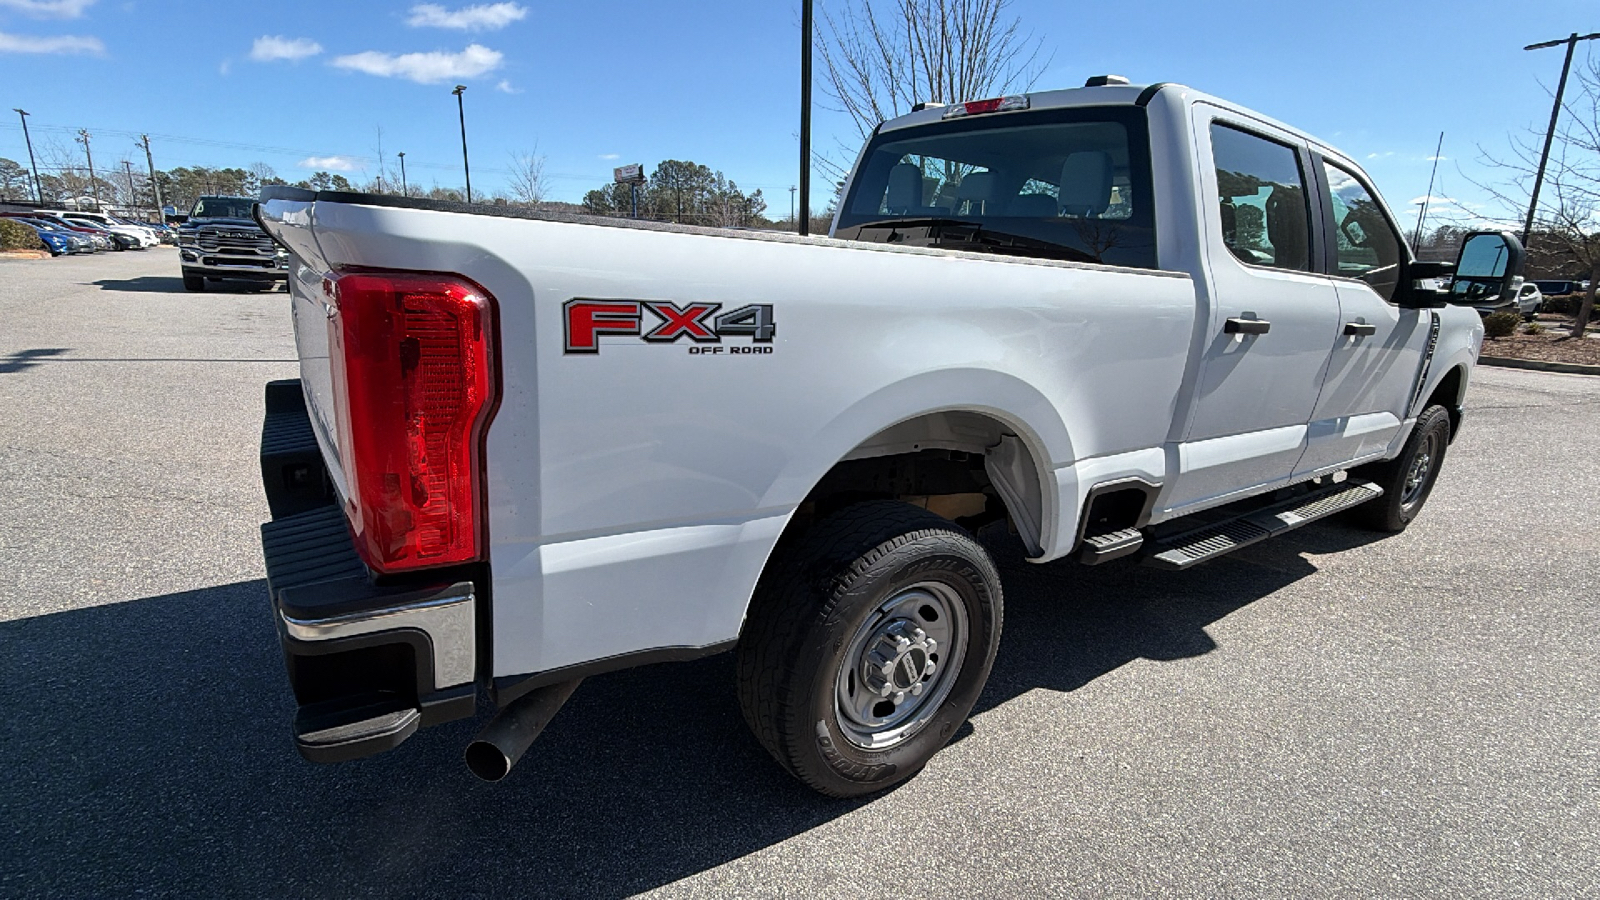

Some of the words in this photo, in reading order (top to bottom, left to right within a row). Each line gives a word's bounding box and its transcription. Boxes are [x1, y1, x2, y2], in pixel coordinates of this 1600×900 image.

[563, 297, 775, 355] FX4
[688, 346, 724, 355] OFF
[729, 346, 774, 355] ROAD
[958, 566, 992, 609] BLADE
[818, 735, 887, 781] ATTURO
